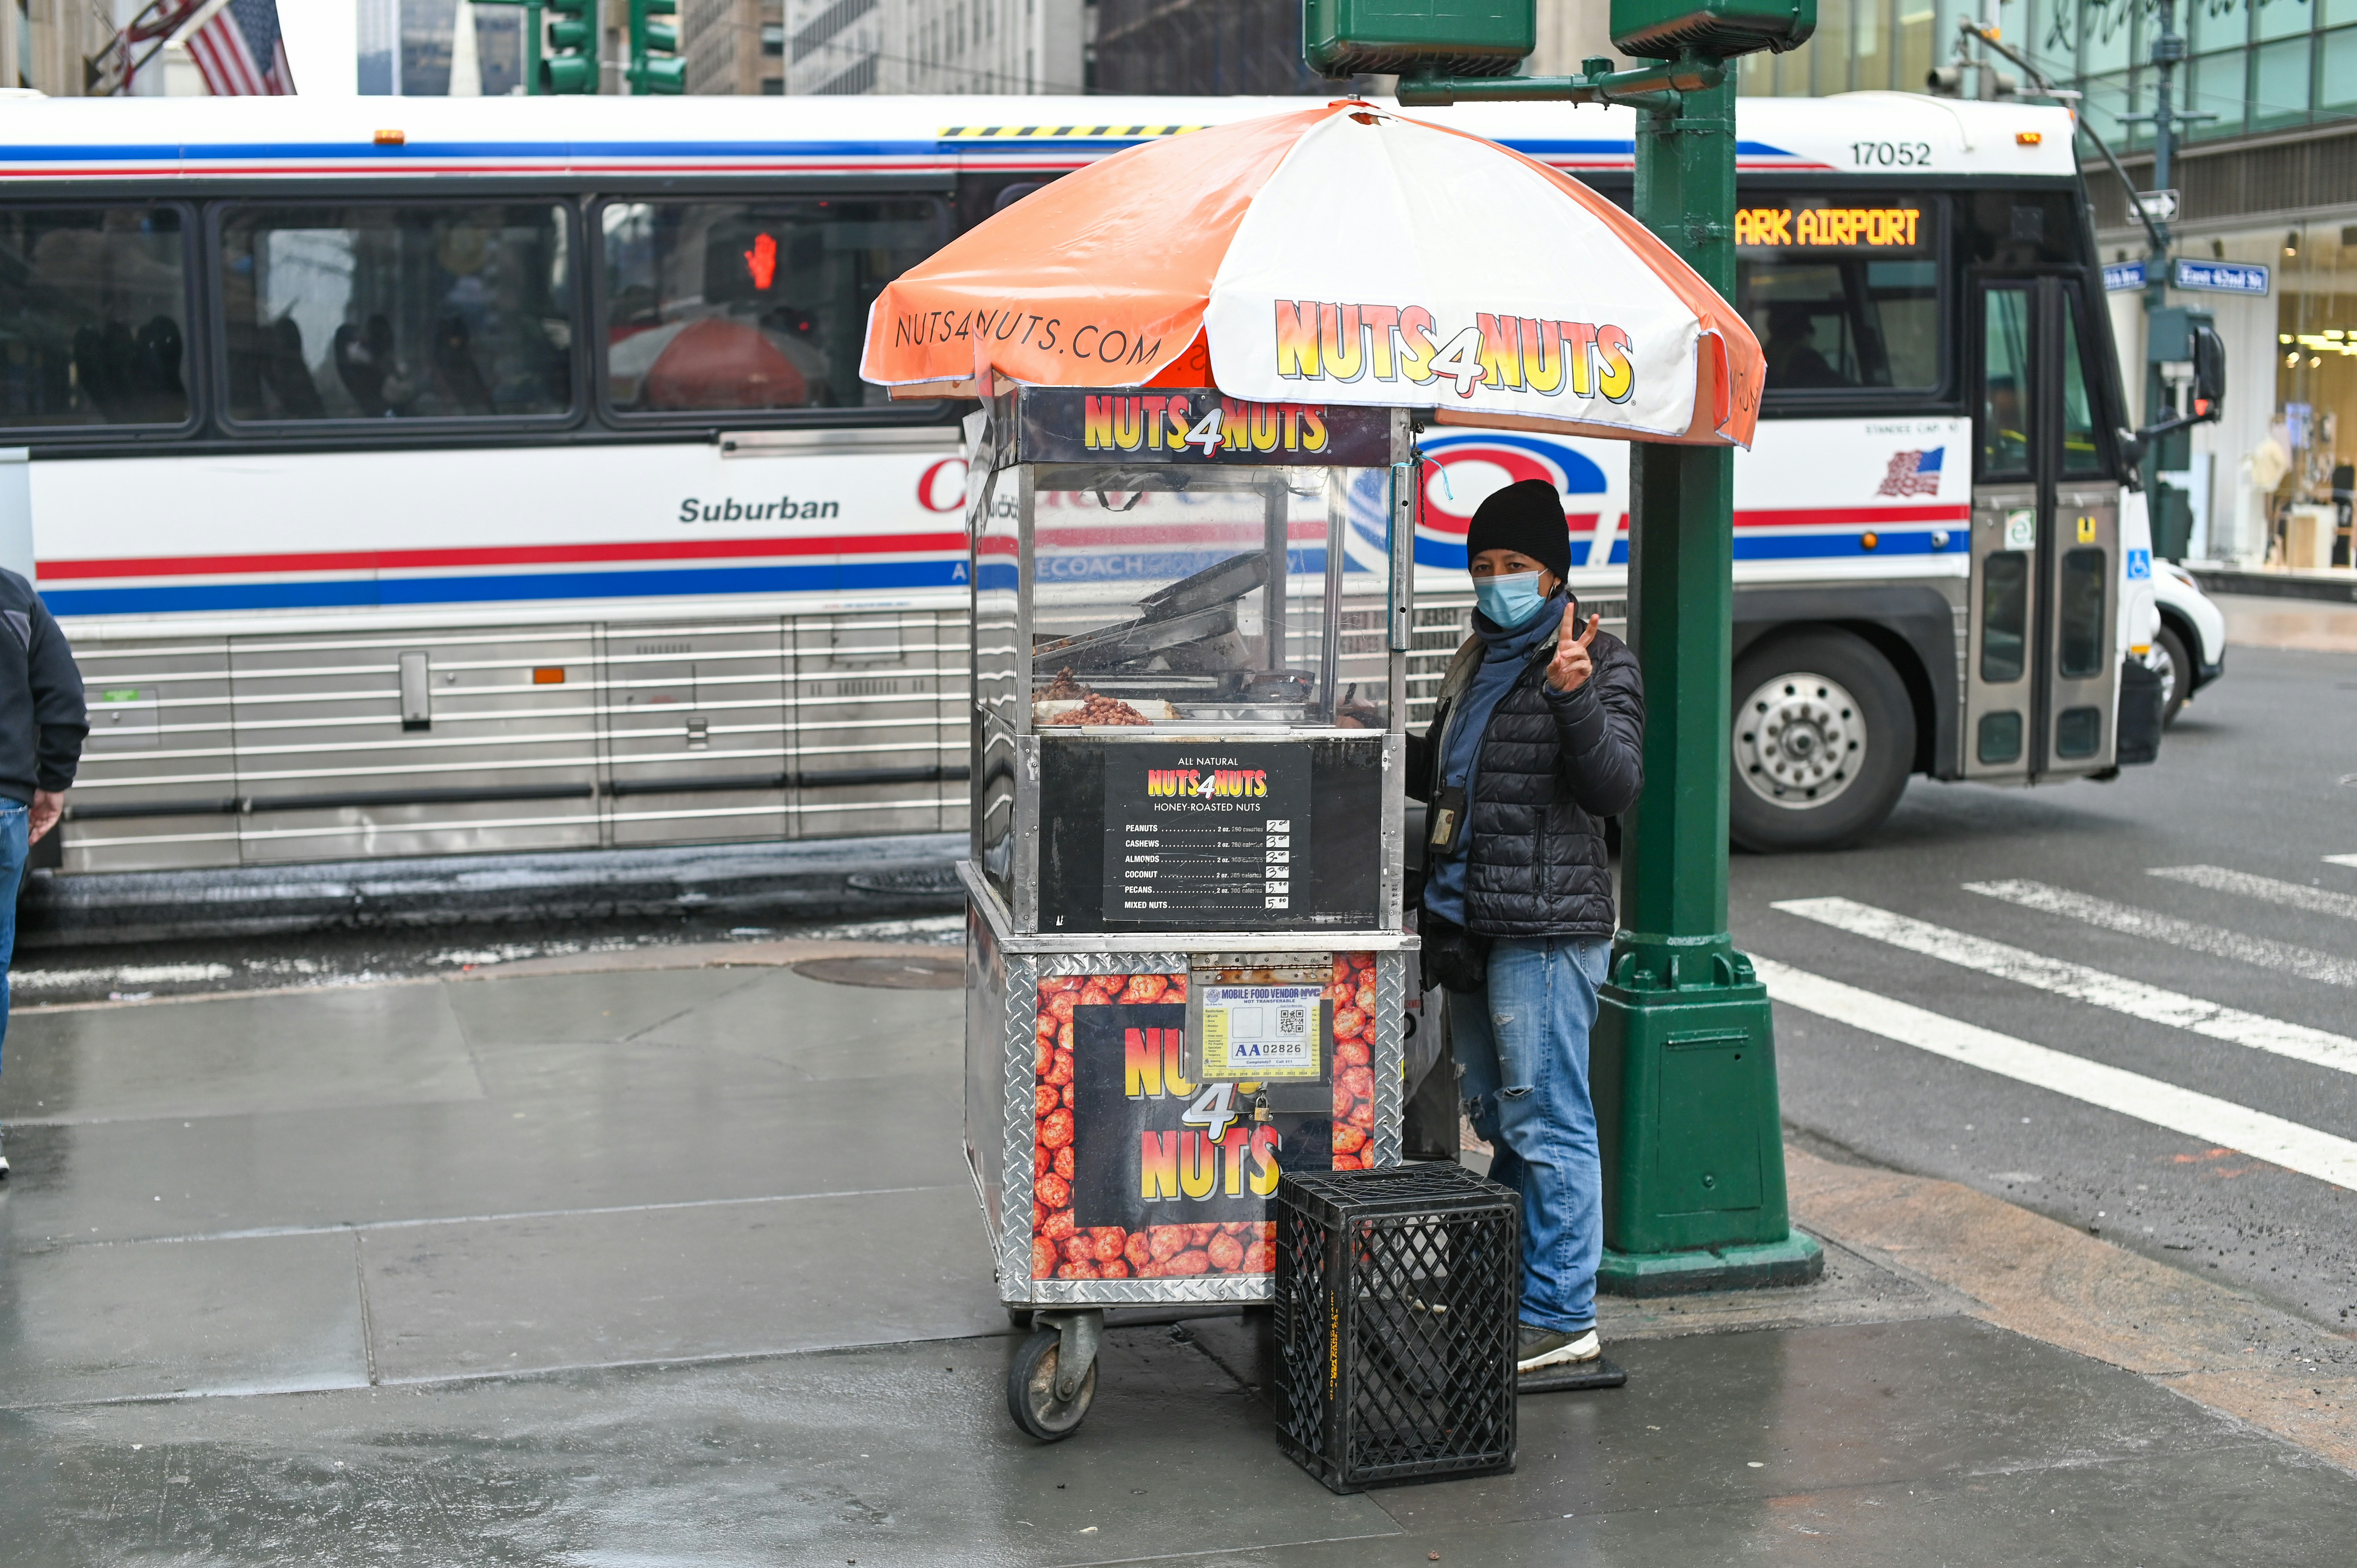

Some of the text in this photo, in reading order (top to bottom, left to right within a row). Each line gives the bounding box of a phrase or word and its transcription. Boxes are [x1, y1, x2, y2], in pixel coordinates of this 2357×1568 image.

[1850, 143, 1931, 166] 17052
[1735, 209, 1920, 245] ARK AIRPORT
[896, 309, 1162, 365] NUTS4NUTS.COM
[678, 496, 839, 523] Suburban
[1178, 757, 1239, 766] ALL NATURAL
[1154, 803, 1260, 812] HONEY-ROASTED NUTS
[1222, 988, 1320, 999] MOBILE FOOD VENDOR NYC
[1235, 1044, 1301, 1056] AA 02826
[1182, 1083, 1239, 1144] 4
[1141, 1125, 1282, 1202] NUTS
